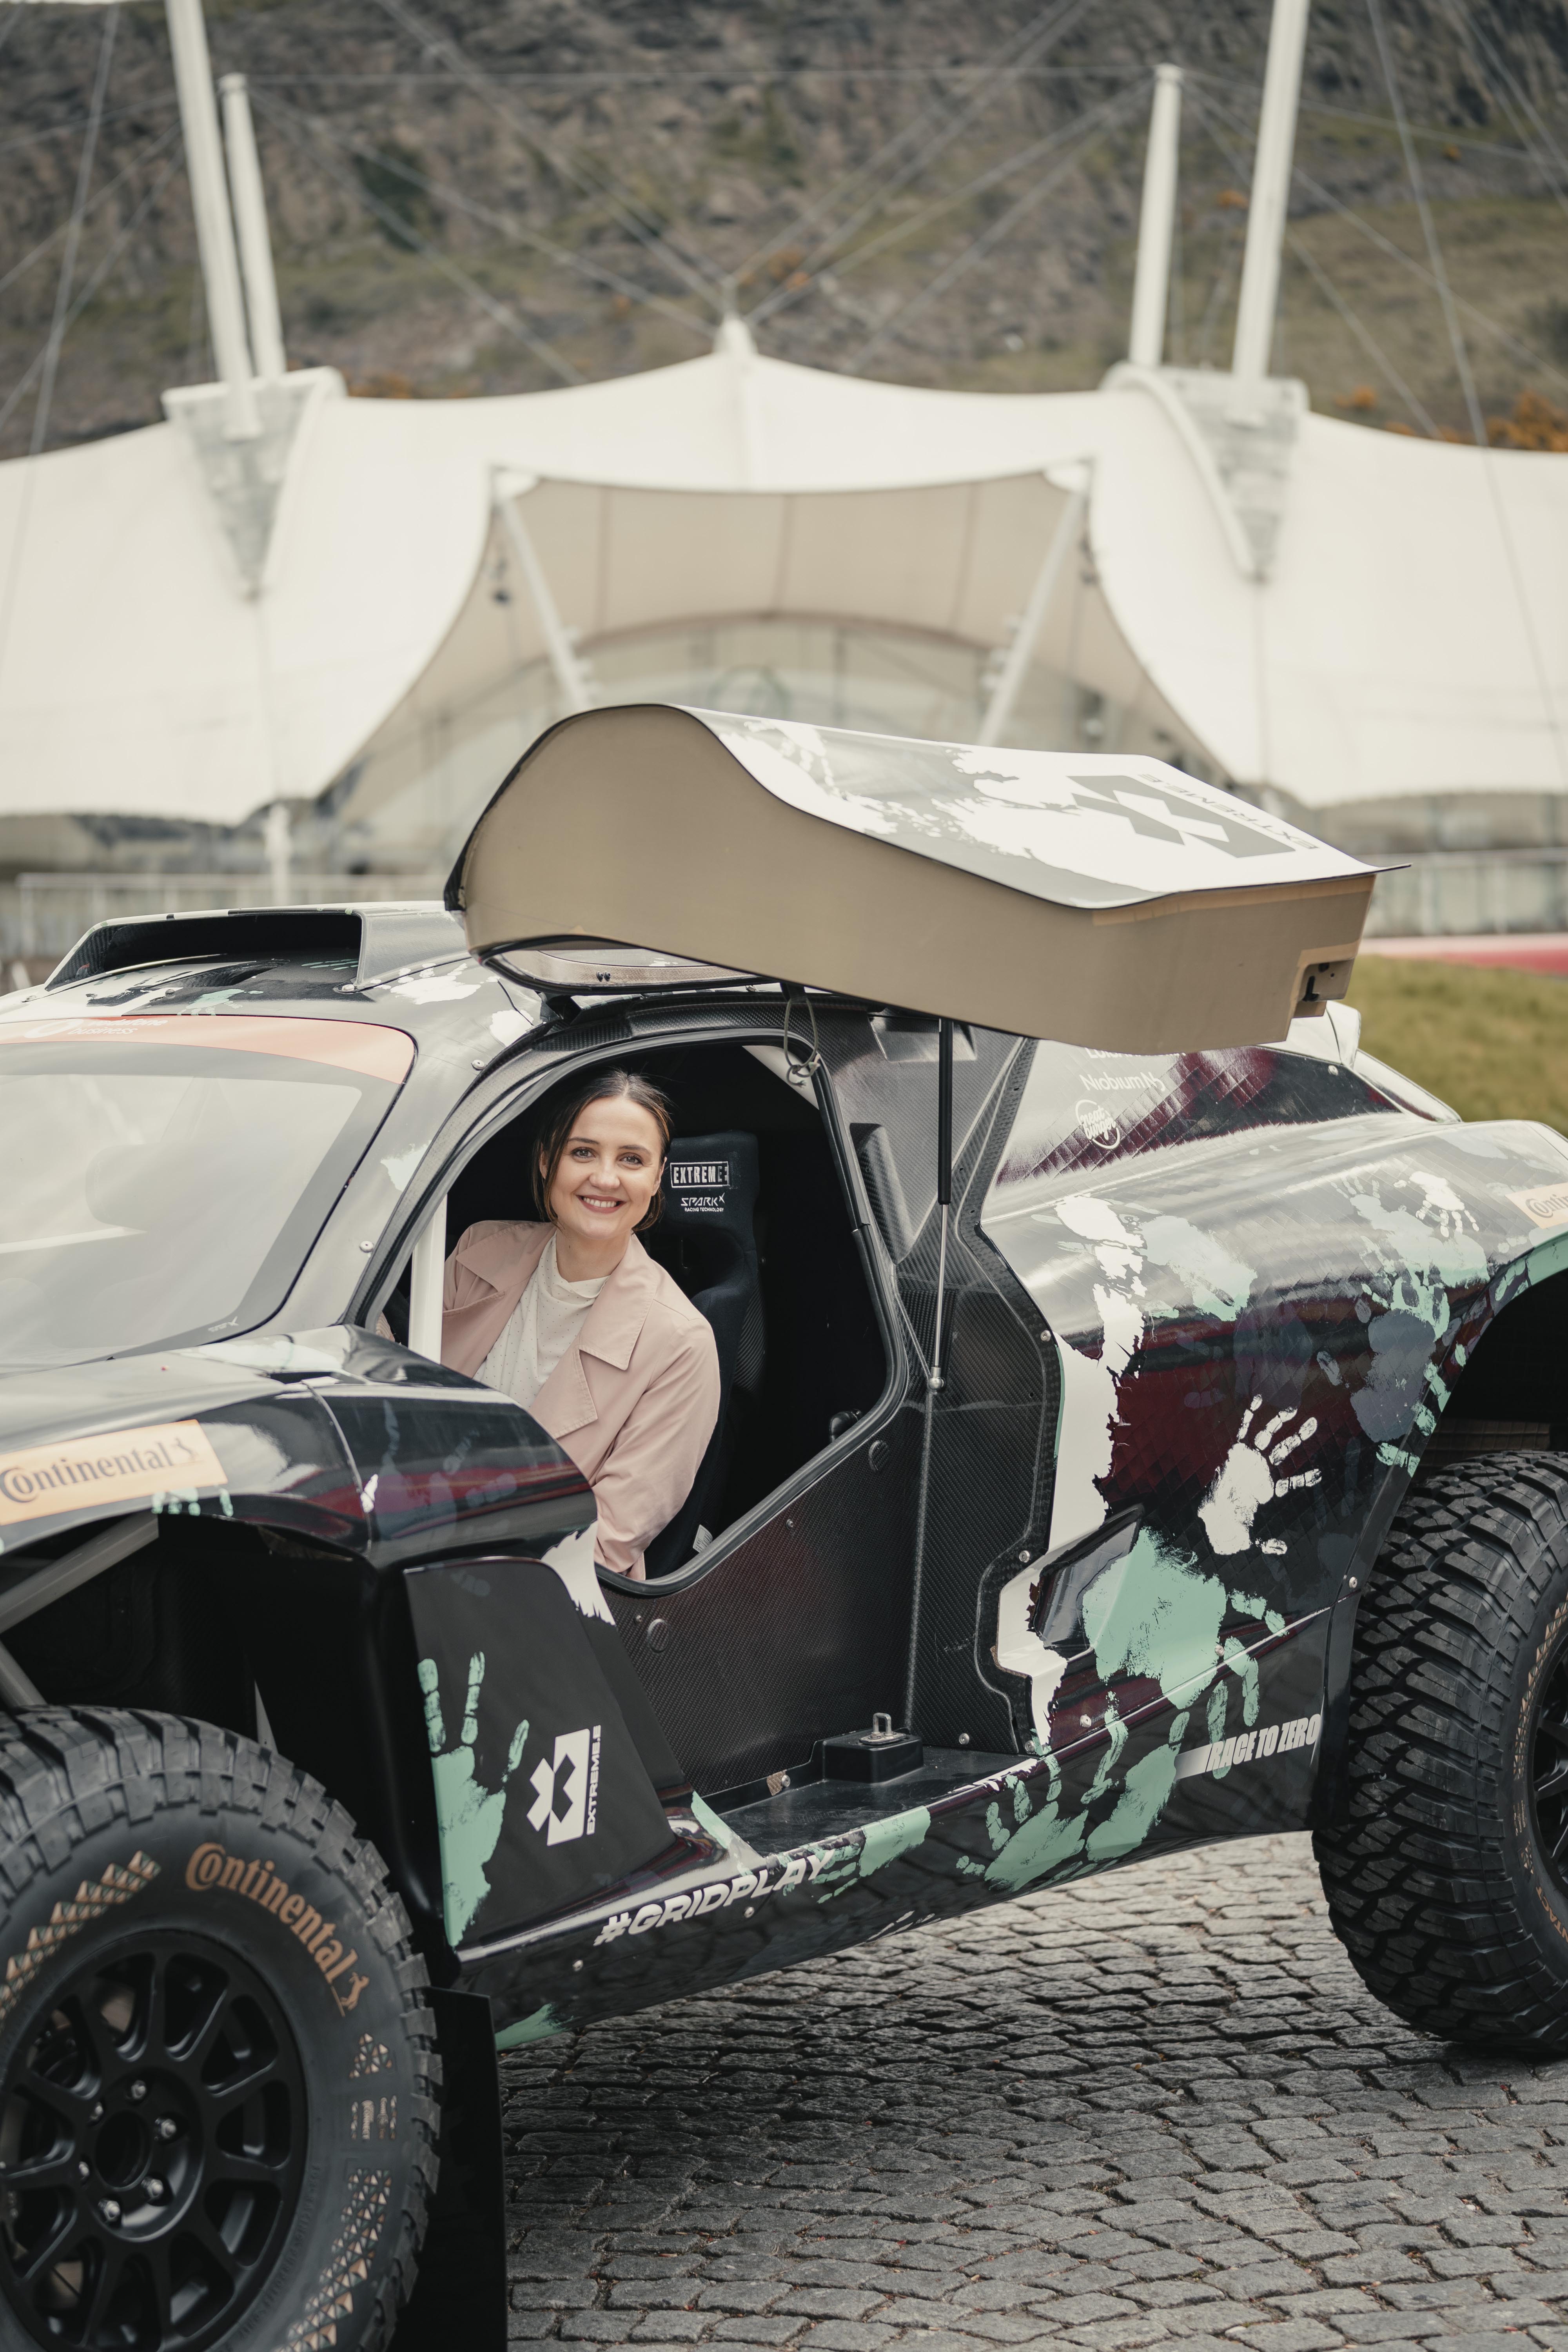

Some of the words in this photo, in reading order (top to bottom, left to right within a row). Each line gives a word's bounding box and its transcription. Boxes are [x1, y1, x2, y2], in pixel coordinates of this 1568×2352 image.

[67, 1026, 138, 1035] business
[0, 1441, 175, 1503] Continental
[1206, 1731, 1258, 1772] RACE
[1255, 1725, 1279, 1759] TO
[1277, 1713, 1321, 1753] ZERO
[185, 1842, 359, 1984] Continental
[593, 1849, 835, 1947] #GRIDPLAY
